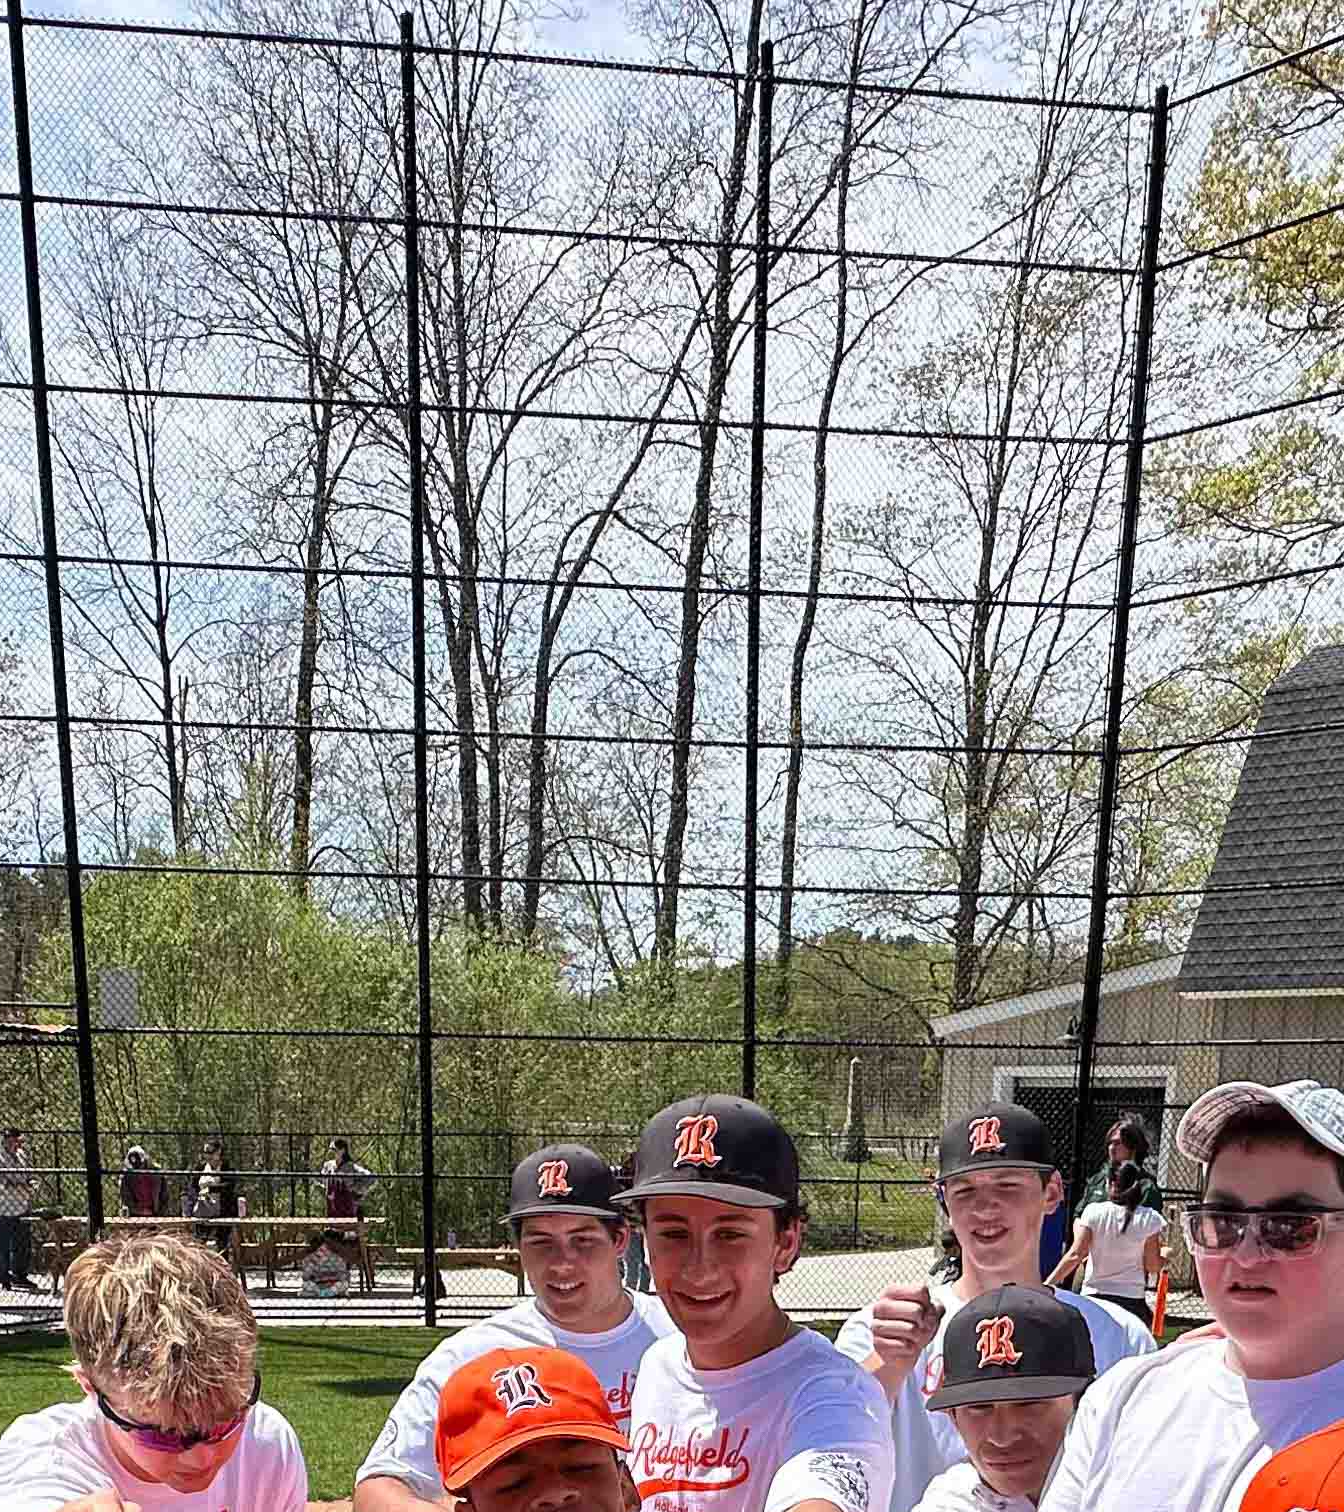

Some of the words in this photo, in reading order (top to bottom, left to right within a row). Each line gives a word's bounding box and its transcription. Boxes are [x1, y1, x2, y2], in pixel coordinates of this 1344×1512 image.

[673, 1114, 723, 1168] R
[969, 1116, 1007, 1155] R
[538, 1160, 573, 1197] R
[976, 1315, 1024, 1369] R
[490, 1362, 553, 1419] R
[632, 1422, 749, 1481] Ridgefield
